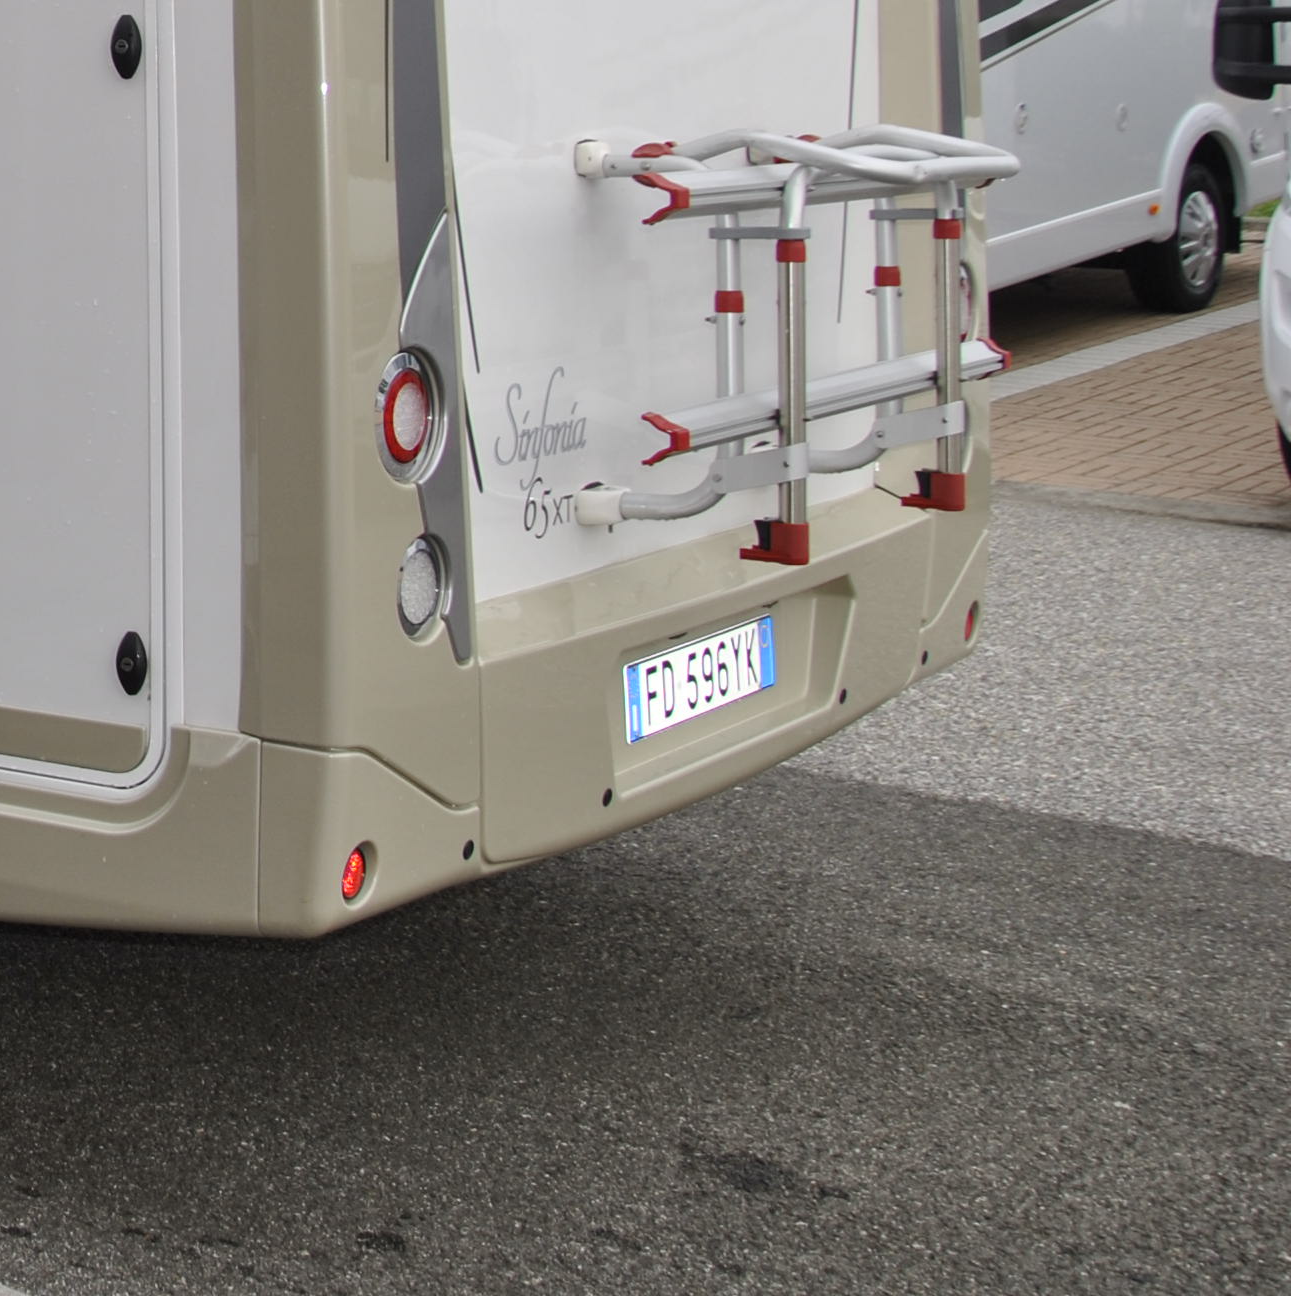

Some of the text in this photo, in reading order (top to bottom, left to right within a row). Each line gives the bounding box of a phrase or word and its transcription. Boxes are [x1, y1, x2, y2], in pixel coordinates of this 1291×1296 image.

[494, 366, 587, 492] Sinfonia
[645, 659, 676, 726] FD
[686, 628, 759, 711] 596YK
